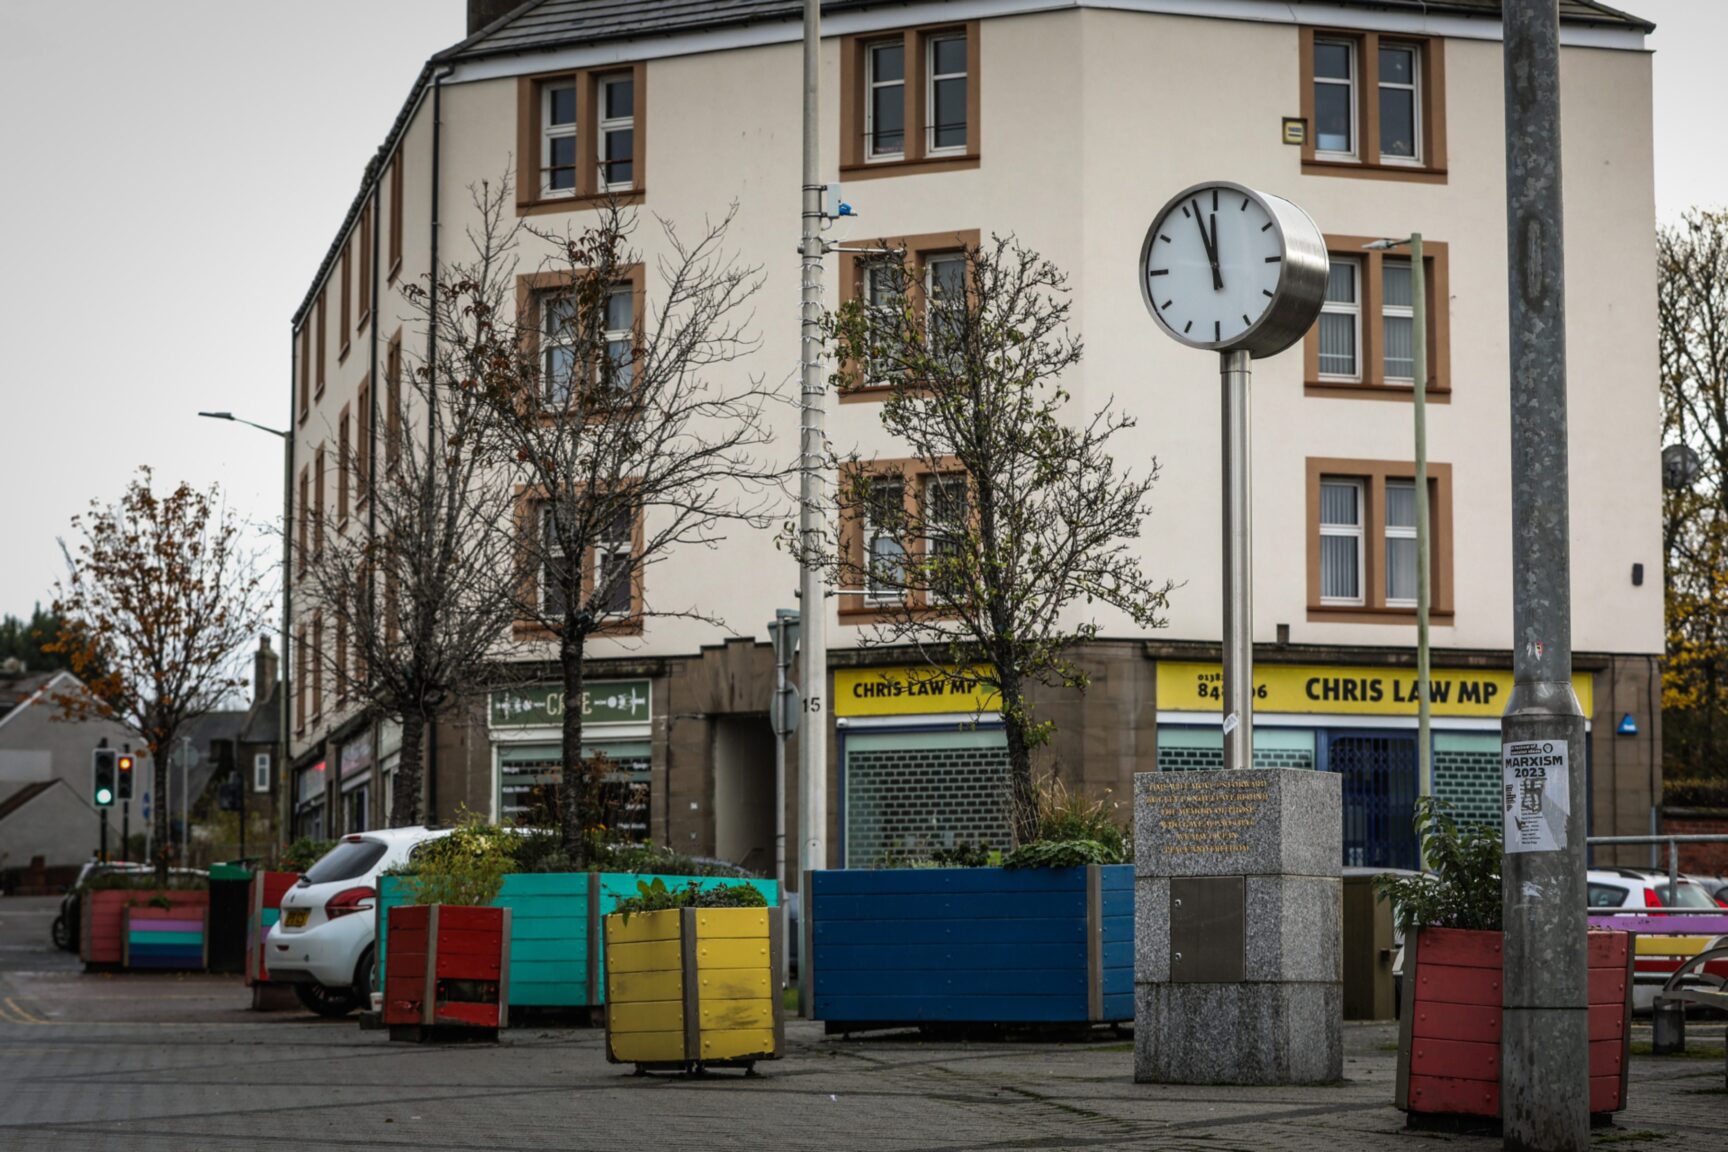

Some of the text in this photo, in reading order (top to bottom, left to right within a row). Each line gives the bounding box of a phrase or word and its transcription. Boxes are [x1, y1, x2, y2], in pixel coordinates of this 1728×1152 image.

[1198, 673, 1223, 682] 0138
[853, 680, 977, 698] CHRIS LAW MP
[1306, 678, 1498, 704] CHRIS LAW MP
[803, 697, 820, 712] 15
[1505, 756, 1563, 768] MARXISM
[1515, 767, 1546, 778] 2023
